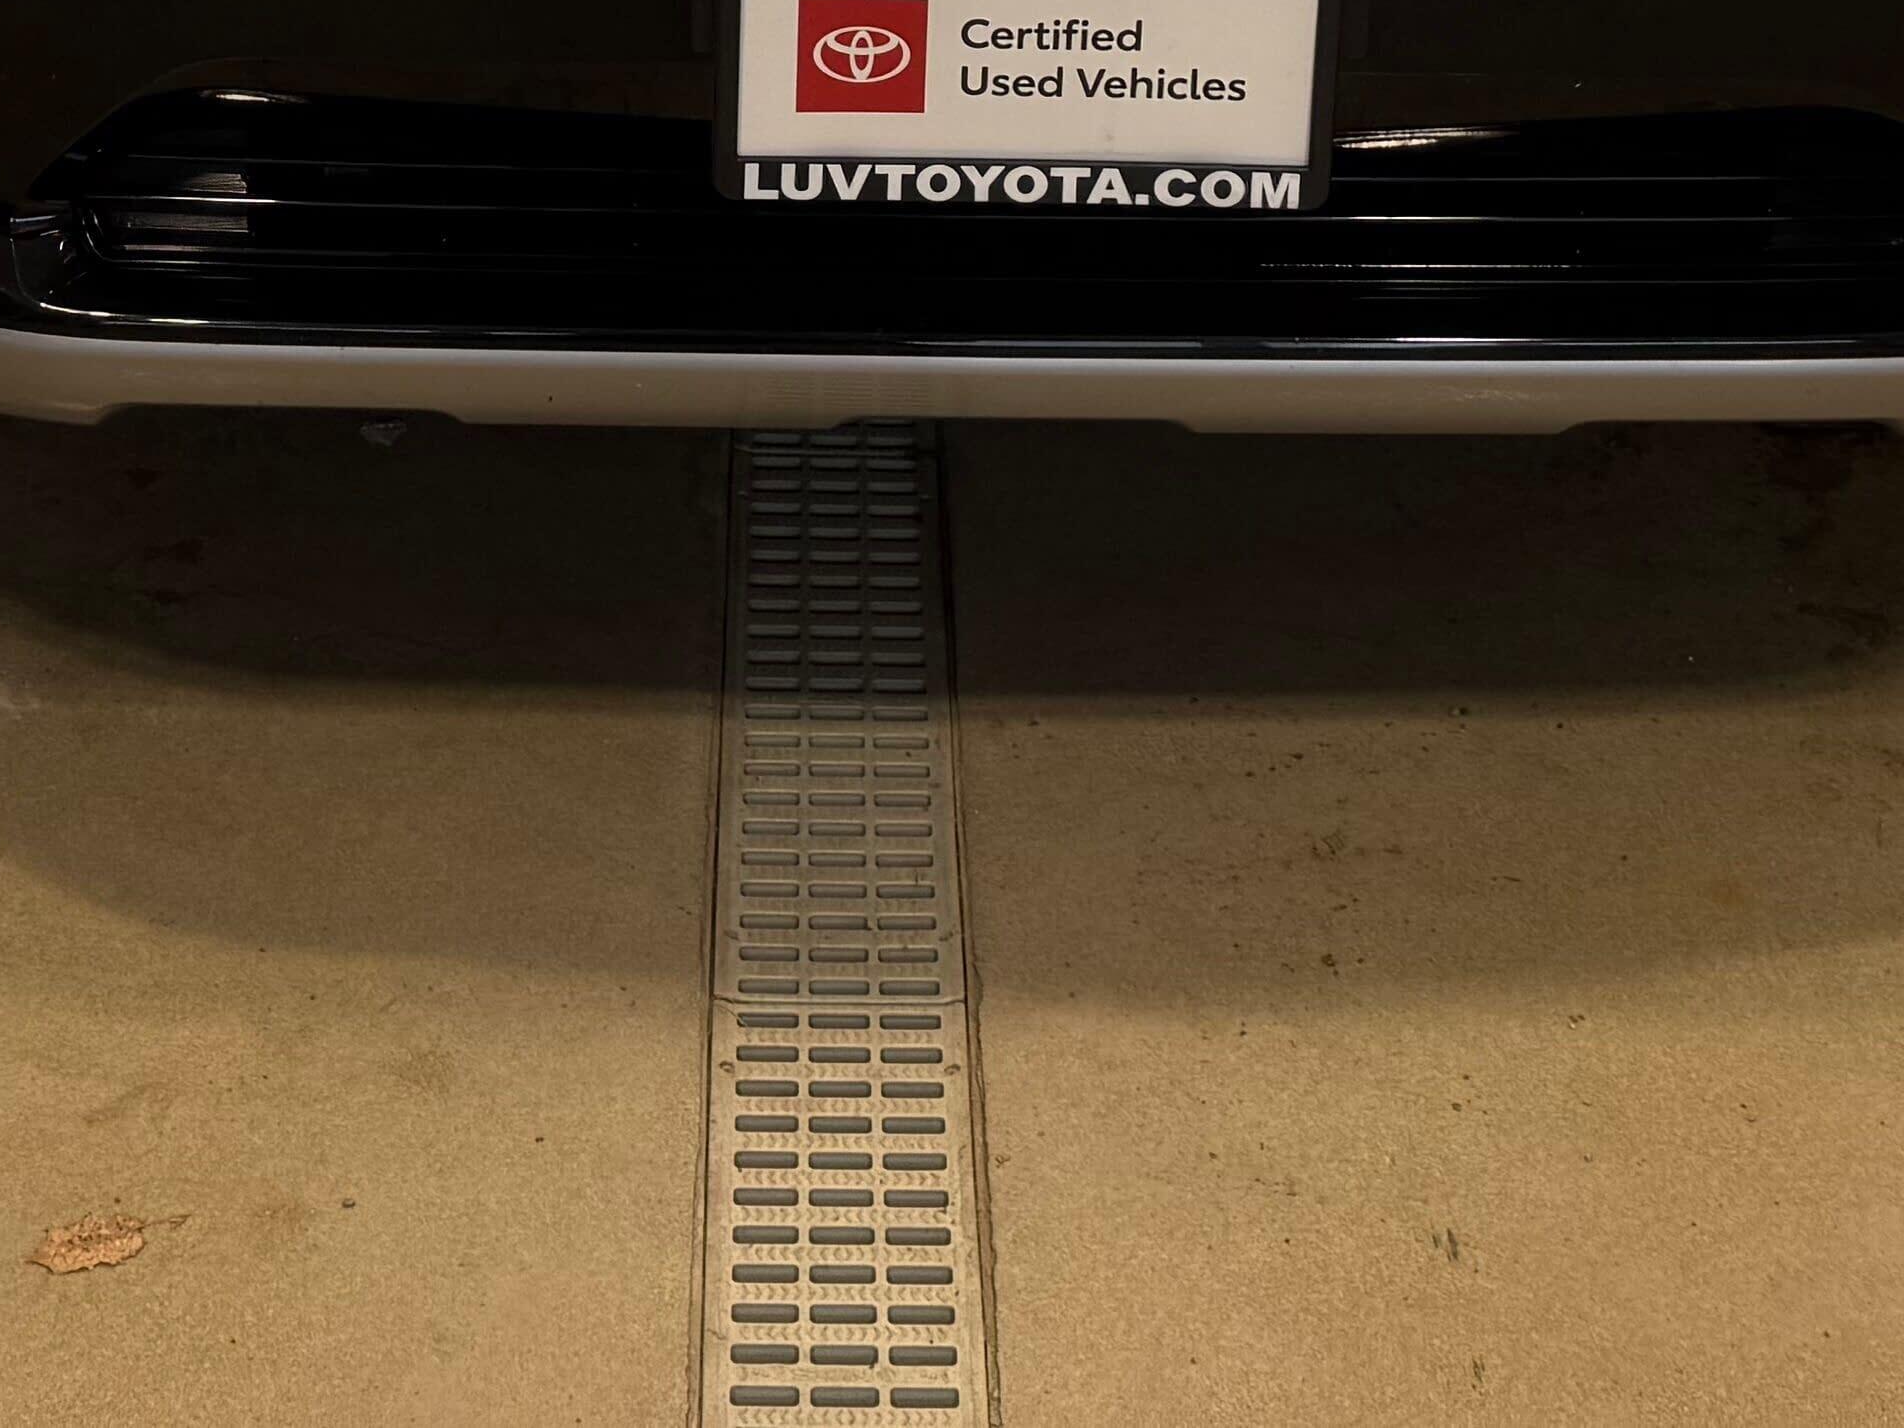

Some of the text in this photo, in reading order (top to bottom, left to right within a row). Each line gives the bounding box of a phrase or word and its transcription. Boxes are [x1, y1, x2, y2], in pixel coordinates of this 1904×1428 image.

[960, 19, 1143, 52] Certified
[960, 65, 1247, 102] Used Vehicles
[743, 163, 1301, 209] LUVTOYOTA.COM
